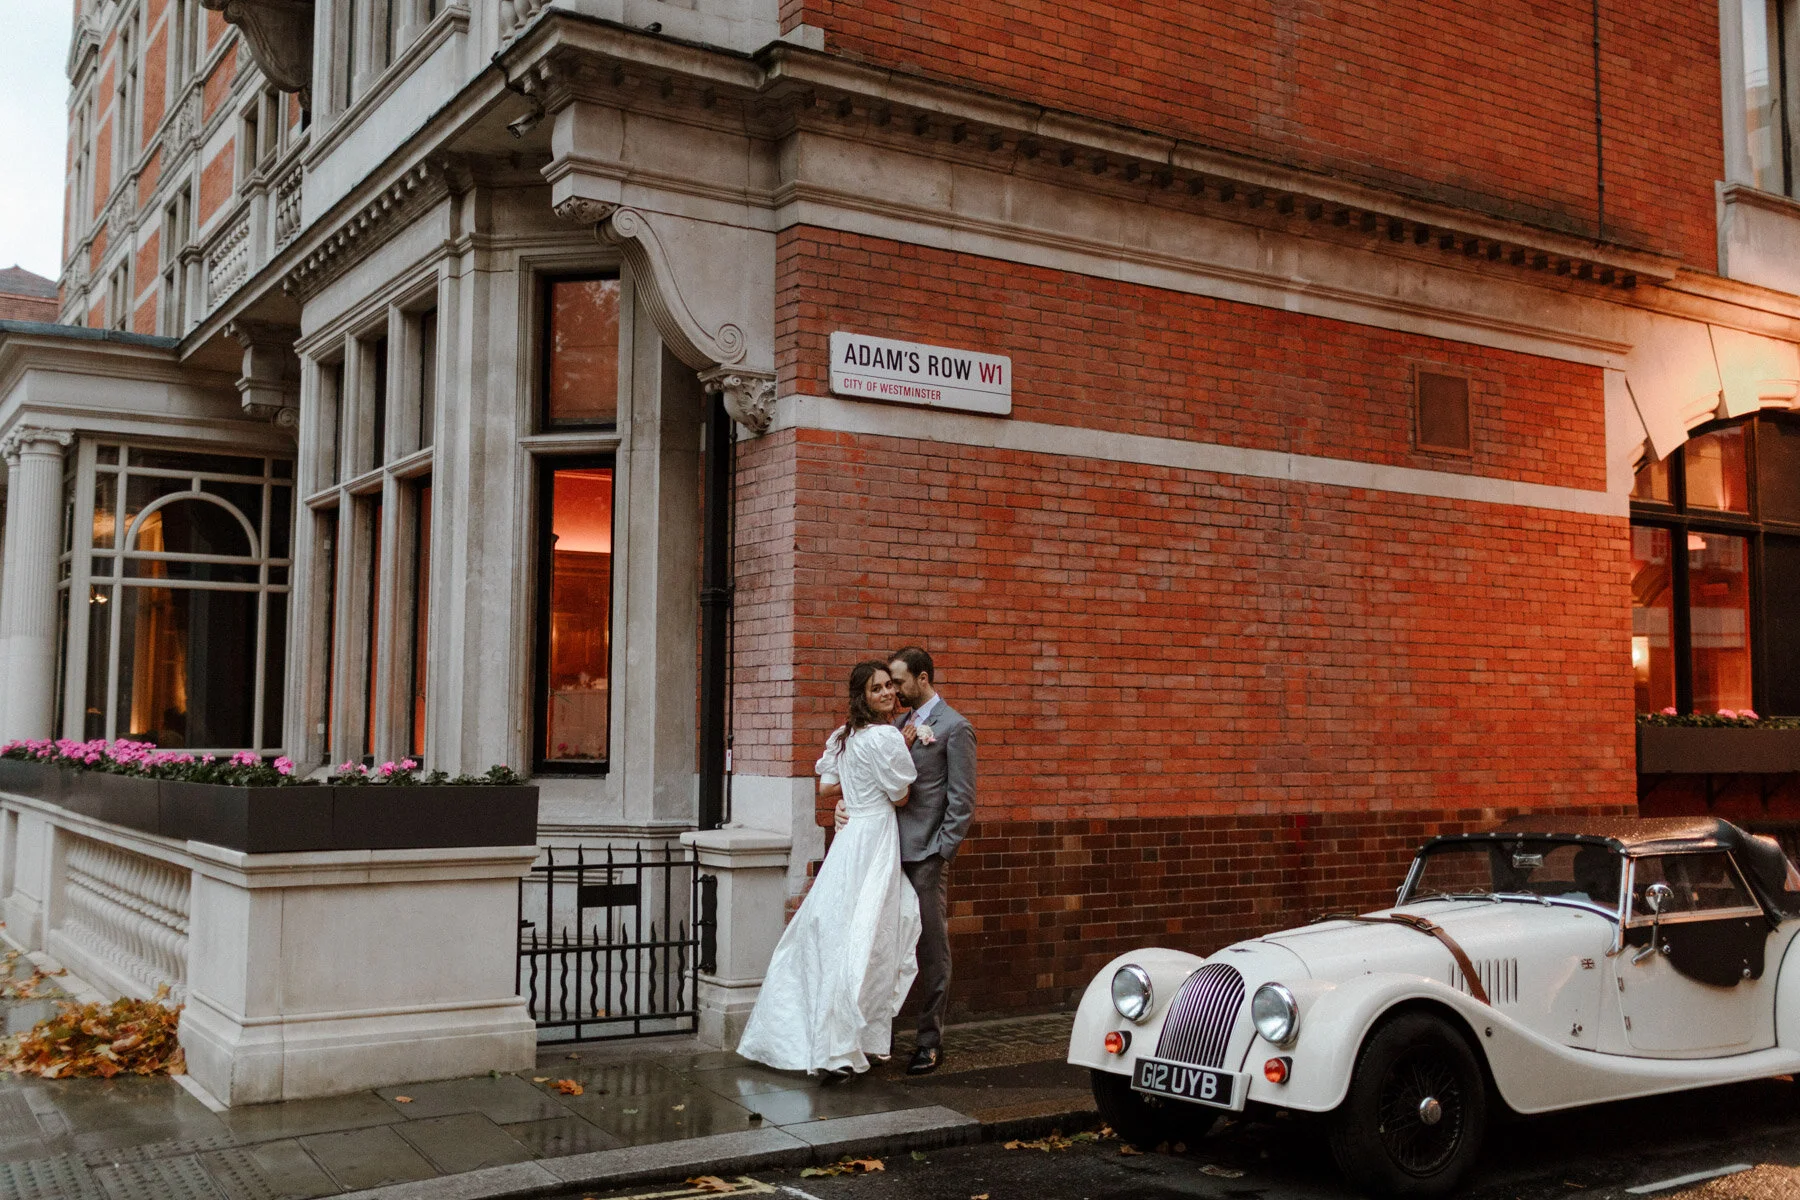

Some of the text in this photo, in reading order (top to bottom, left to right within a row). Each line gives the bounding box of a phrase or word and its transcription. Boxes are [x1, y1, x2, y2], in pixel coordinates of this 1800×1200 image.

[844, 343, 1003, 385] ADAM'S ROW W1
[843, 378, 942, 401] CITY OF WESTMINSTER
[1141, 1062, 1218, 1100] G12 UYB
